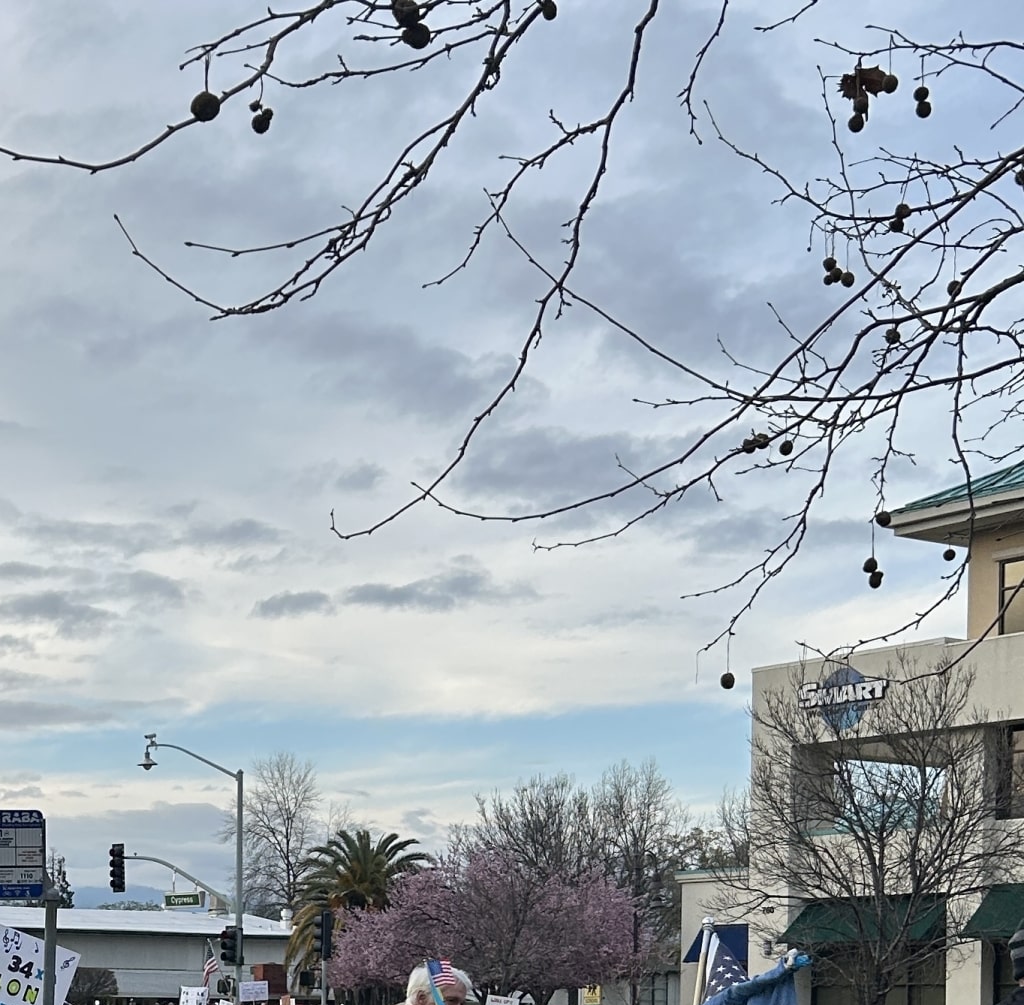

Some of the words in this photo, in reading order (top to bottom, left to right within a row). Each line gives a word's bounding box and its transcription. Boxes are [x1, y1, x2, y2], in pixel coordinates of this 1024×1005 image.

[798, 679, 888, 708] SMART
[1, 811, 41, 823] RABA
[170, 896, 194, 905] Cypress
